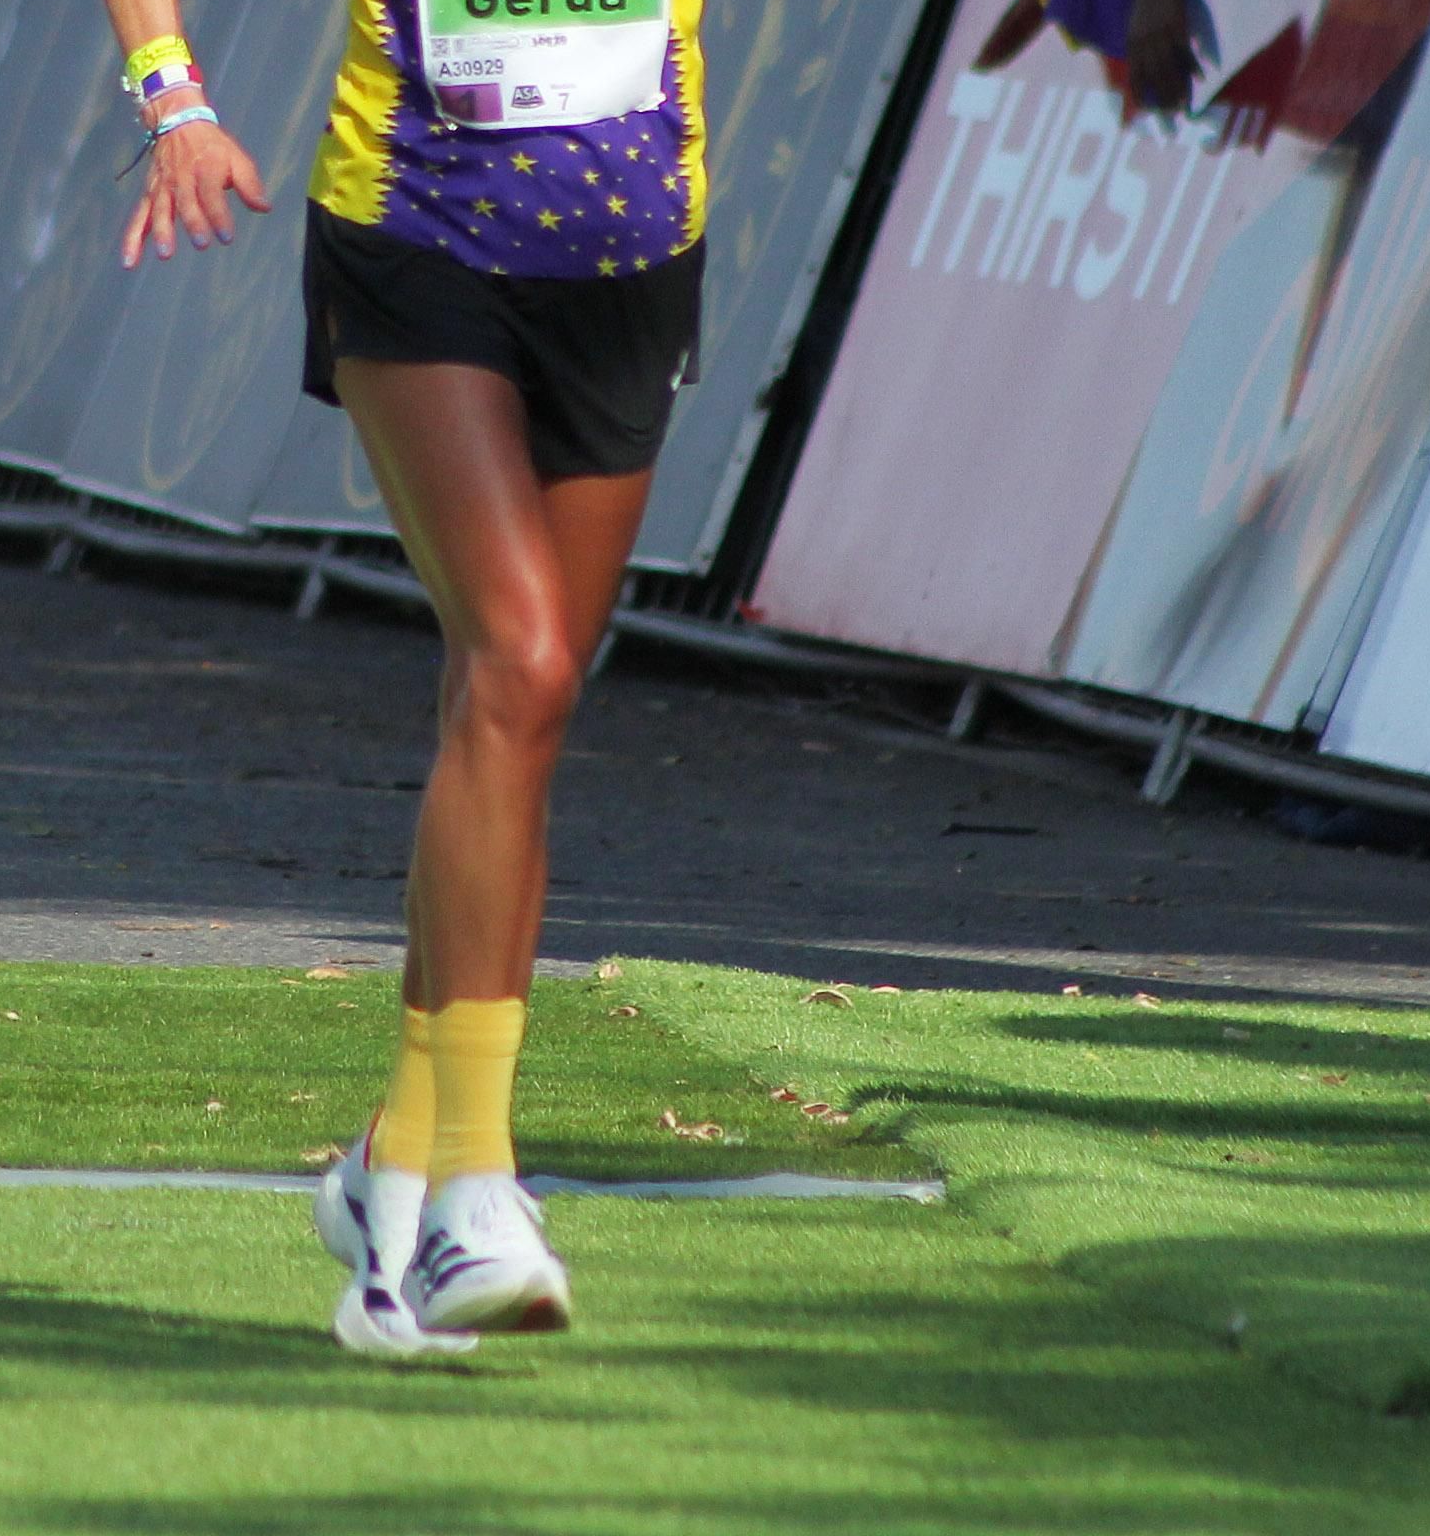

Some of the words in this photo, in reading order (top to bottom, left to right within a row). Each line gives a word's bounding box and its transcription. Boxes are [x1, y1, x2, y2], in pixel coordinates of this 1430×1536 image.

[438, 59, 504, 78] A30929
[514, 87, 541, 101] ASA
[557, 92, 571, 111] 7
